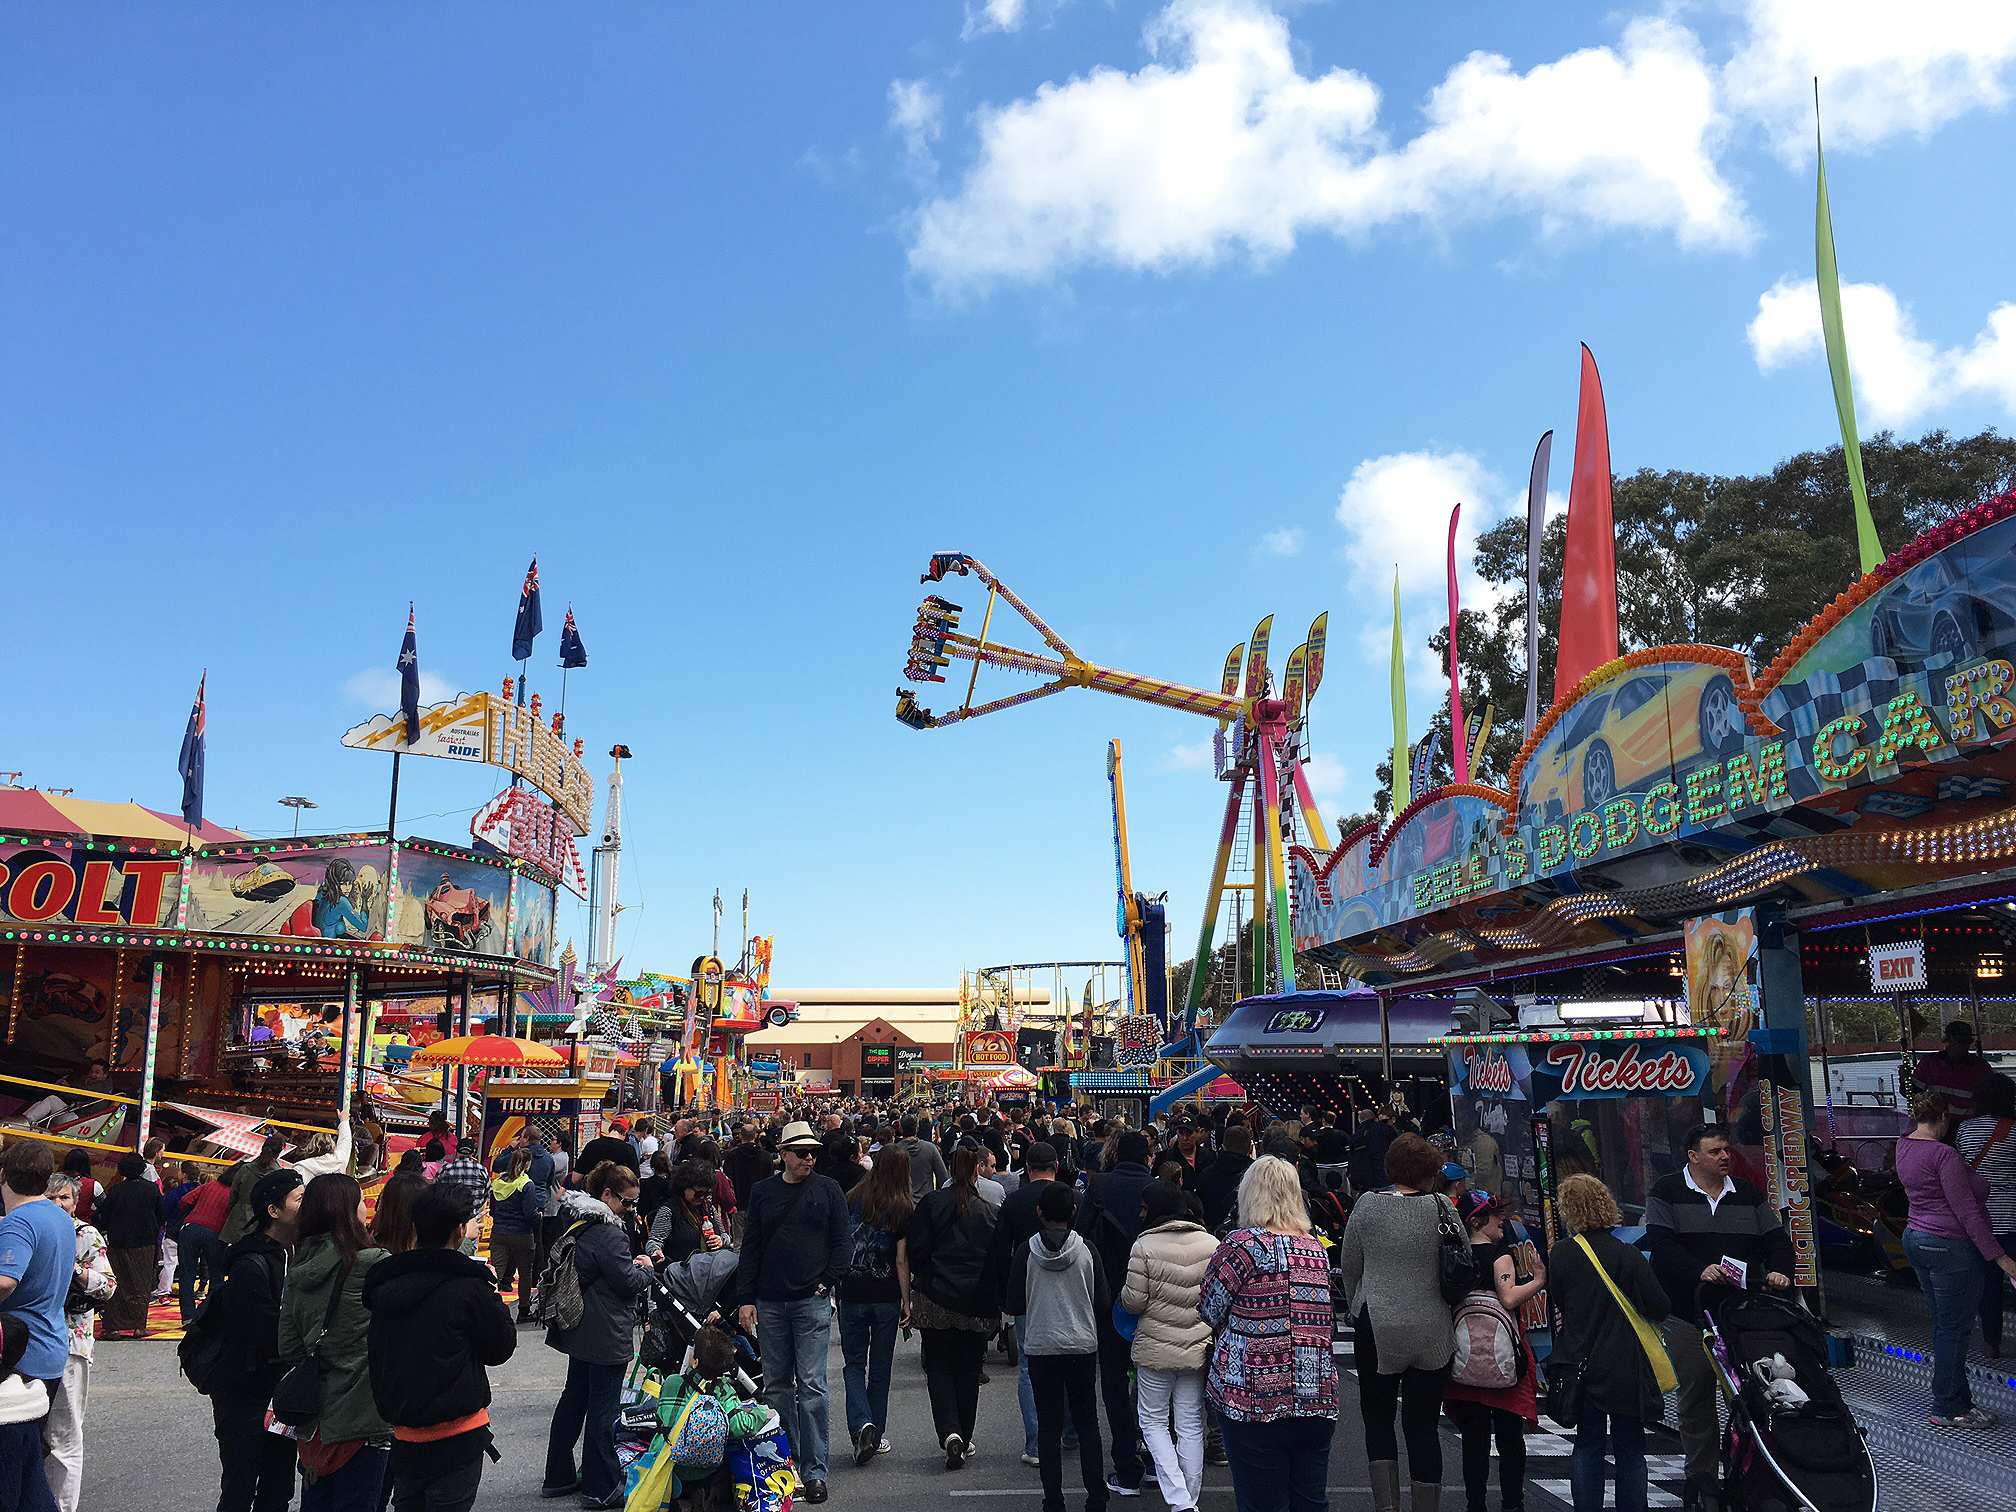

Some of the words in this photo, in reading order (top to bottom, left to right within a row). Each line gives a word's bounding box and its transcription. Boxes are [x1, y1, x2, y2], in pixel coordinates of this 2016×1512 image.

[447, 744, 481, 758] RIDE
[1539, 739, 1790, 871] DODGEM
[0, 860, 181, 927] OLT
[1878, 956, 1915, 980] EXIT
[975, 1053, 989, 1061] HOT
[989, 1053, 1007, 1061] FOOD
[1462, 1045, 1513, 1093] Tickets
[1546, 1043, 1696, 1094] Tickets
[500, 1098, 561, 1111] TICKETS
[1758, 1078, 1775, 1132] CARS
[77, 1125, 92, 1136] 10
[1776, 1085, 1810, 1193] SPEEDWAY
[1787, 1195, 1818, 1288] ELECTRIC
